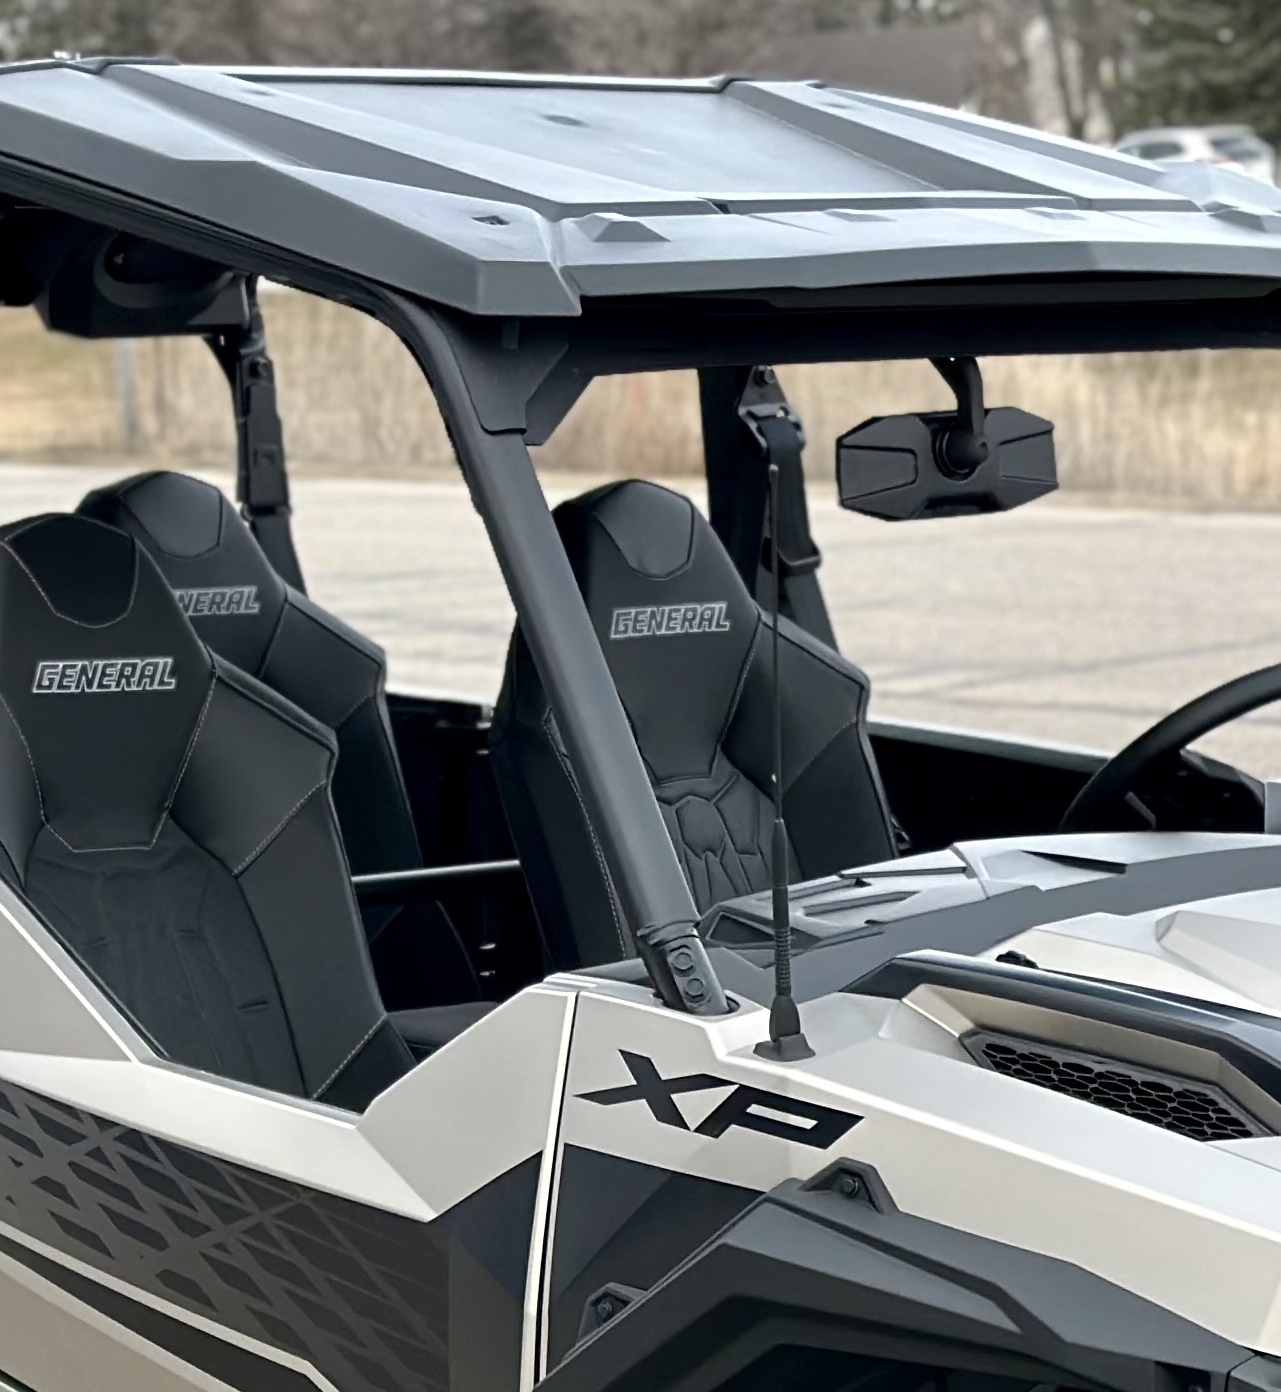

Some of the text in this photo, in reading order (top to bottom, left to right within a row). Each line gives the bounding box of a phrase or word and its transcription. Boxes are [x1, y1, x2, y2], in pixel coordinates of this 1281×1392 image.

[174, 586, 260, 616] NERAL
[609, 601, 731, 640] GENERAL
[32, 657, 176, 693] GENERAL
[573, 1048, 865, 1150] XP
